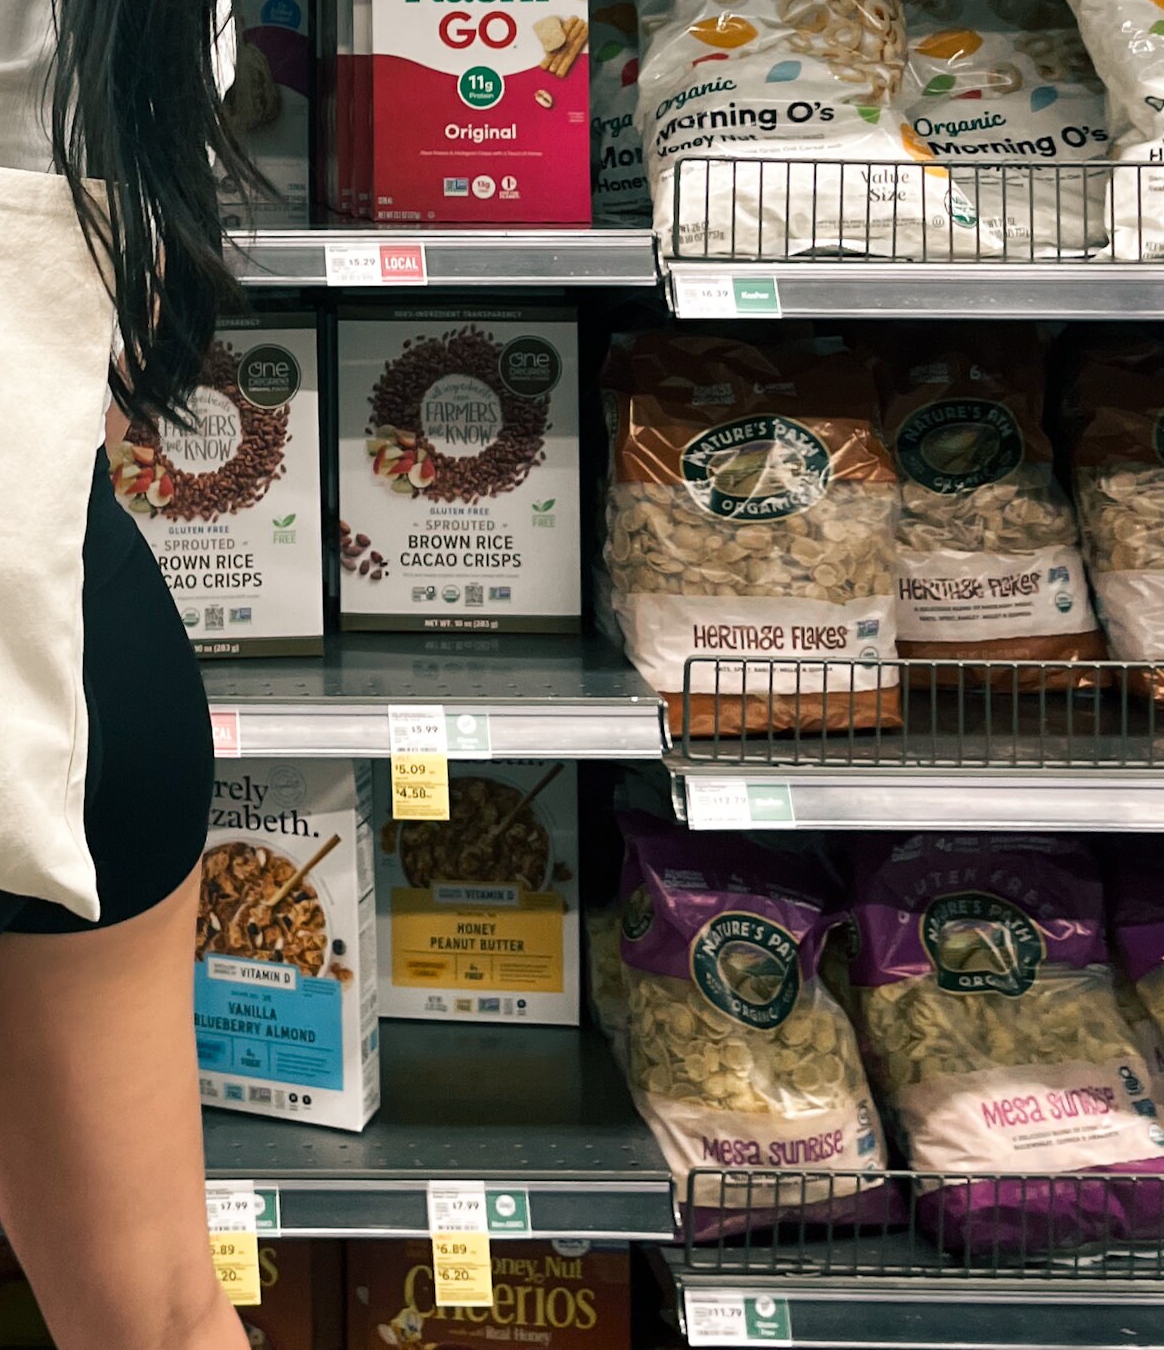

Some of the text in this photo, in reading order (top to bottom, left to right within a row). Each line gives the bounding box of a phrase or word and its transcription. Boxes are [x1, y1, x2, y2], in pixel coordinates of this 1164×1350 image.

[439, 11, 517, 49] GO
[655, 102, 835, 144] Morning O's
[445, 124, 517, 143] Original
[928, 125, 1109, 158] Morning O's
[384, 257, 418, 270] LOCAL
[740, 291, 769, 300] Kosher
[425, 402, 497, 424] FARMERS
[426, 520, 495, 531] SPROUTED
[164, 539, 235, 550] SPROUTED
[408, 535, 514, 550] BROWN RICE
[400, 553, 522, 568] CACAO CRISPS
[203, 572, 263, 588] CRISPS
[395, 763, 426, 776] $5.09
[457, 923, 496, 936] HONEY
[430, 936, 525, 951] PEANUT BUTTER
[240, 968, 291, 983] VITAMIN D
[228, 1002, 277, 1021] VANILLA
[194, 1013, 316, 1042] BLUEBERRY ALMOND
[452, 1201, 479, 1211] $7.99
[437, 1244, 467, 1255] $6.89
[438, 1270, 469, 1282] $6.20
